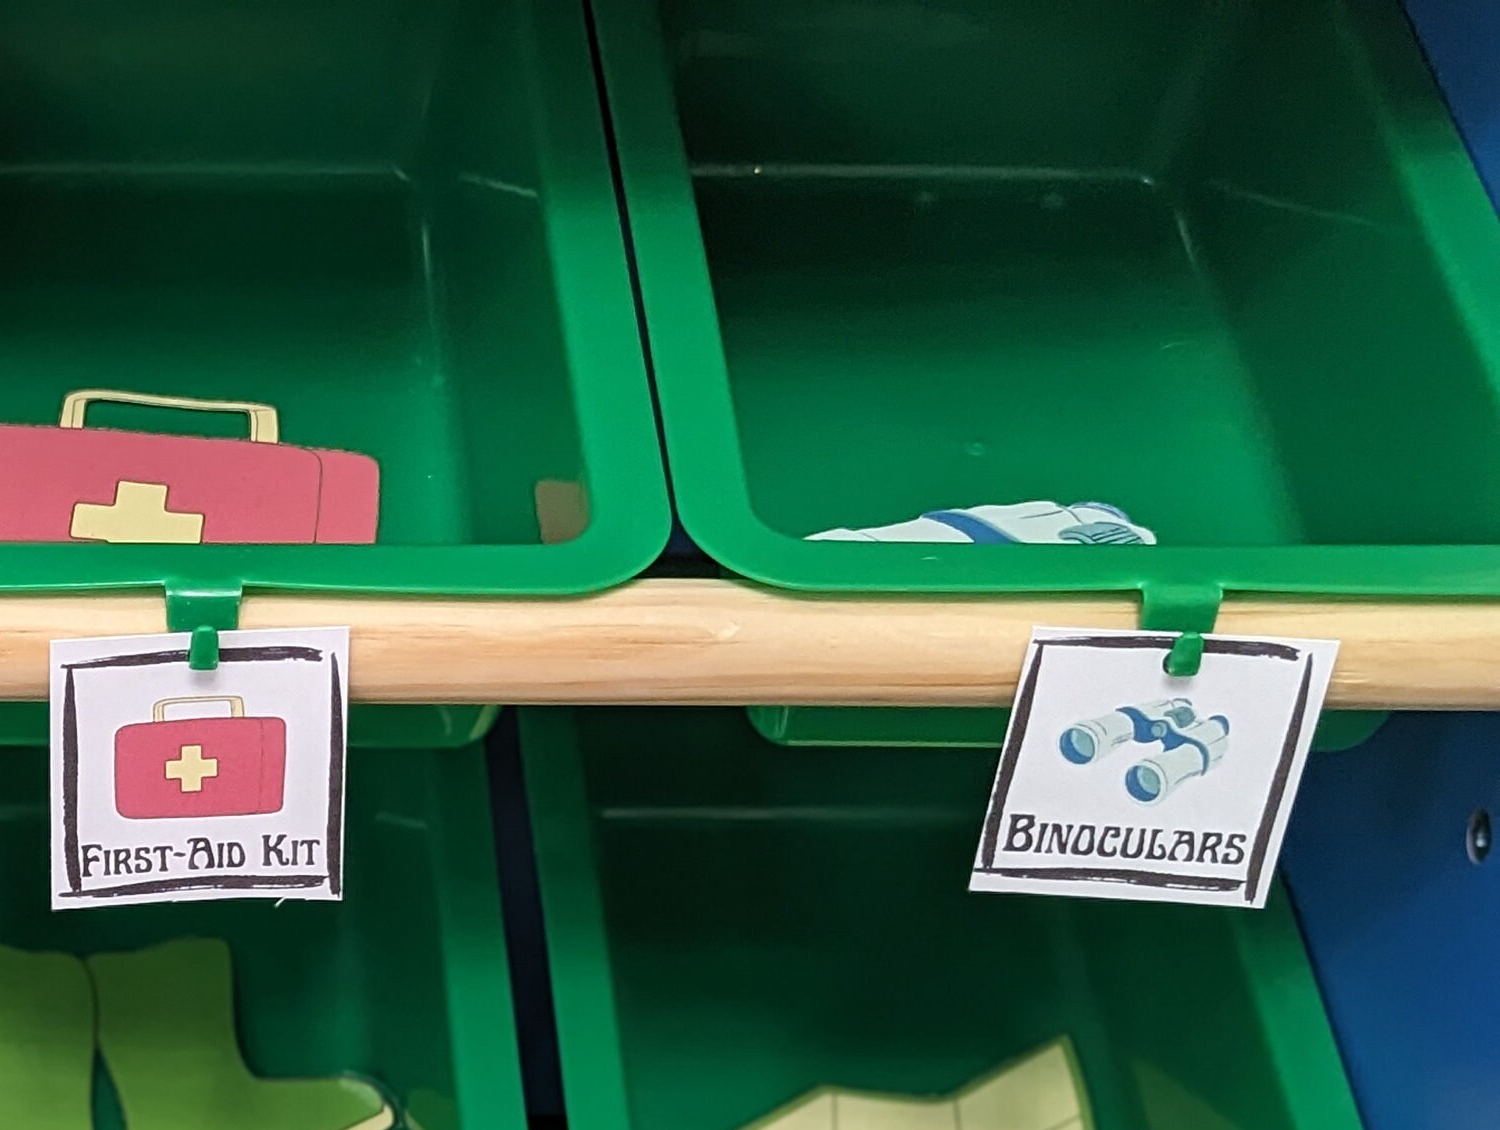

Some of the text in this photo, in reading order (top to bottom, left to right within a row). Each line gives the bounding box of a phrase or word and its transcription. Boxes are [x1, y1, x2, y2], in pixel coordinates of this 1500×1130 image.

[80, 834, 321, 878] FIRST-AID KIT
[1001, 813, 1248, 865] BINOCULARS
